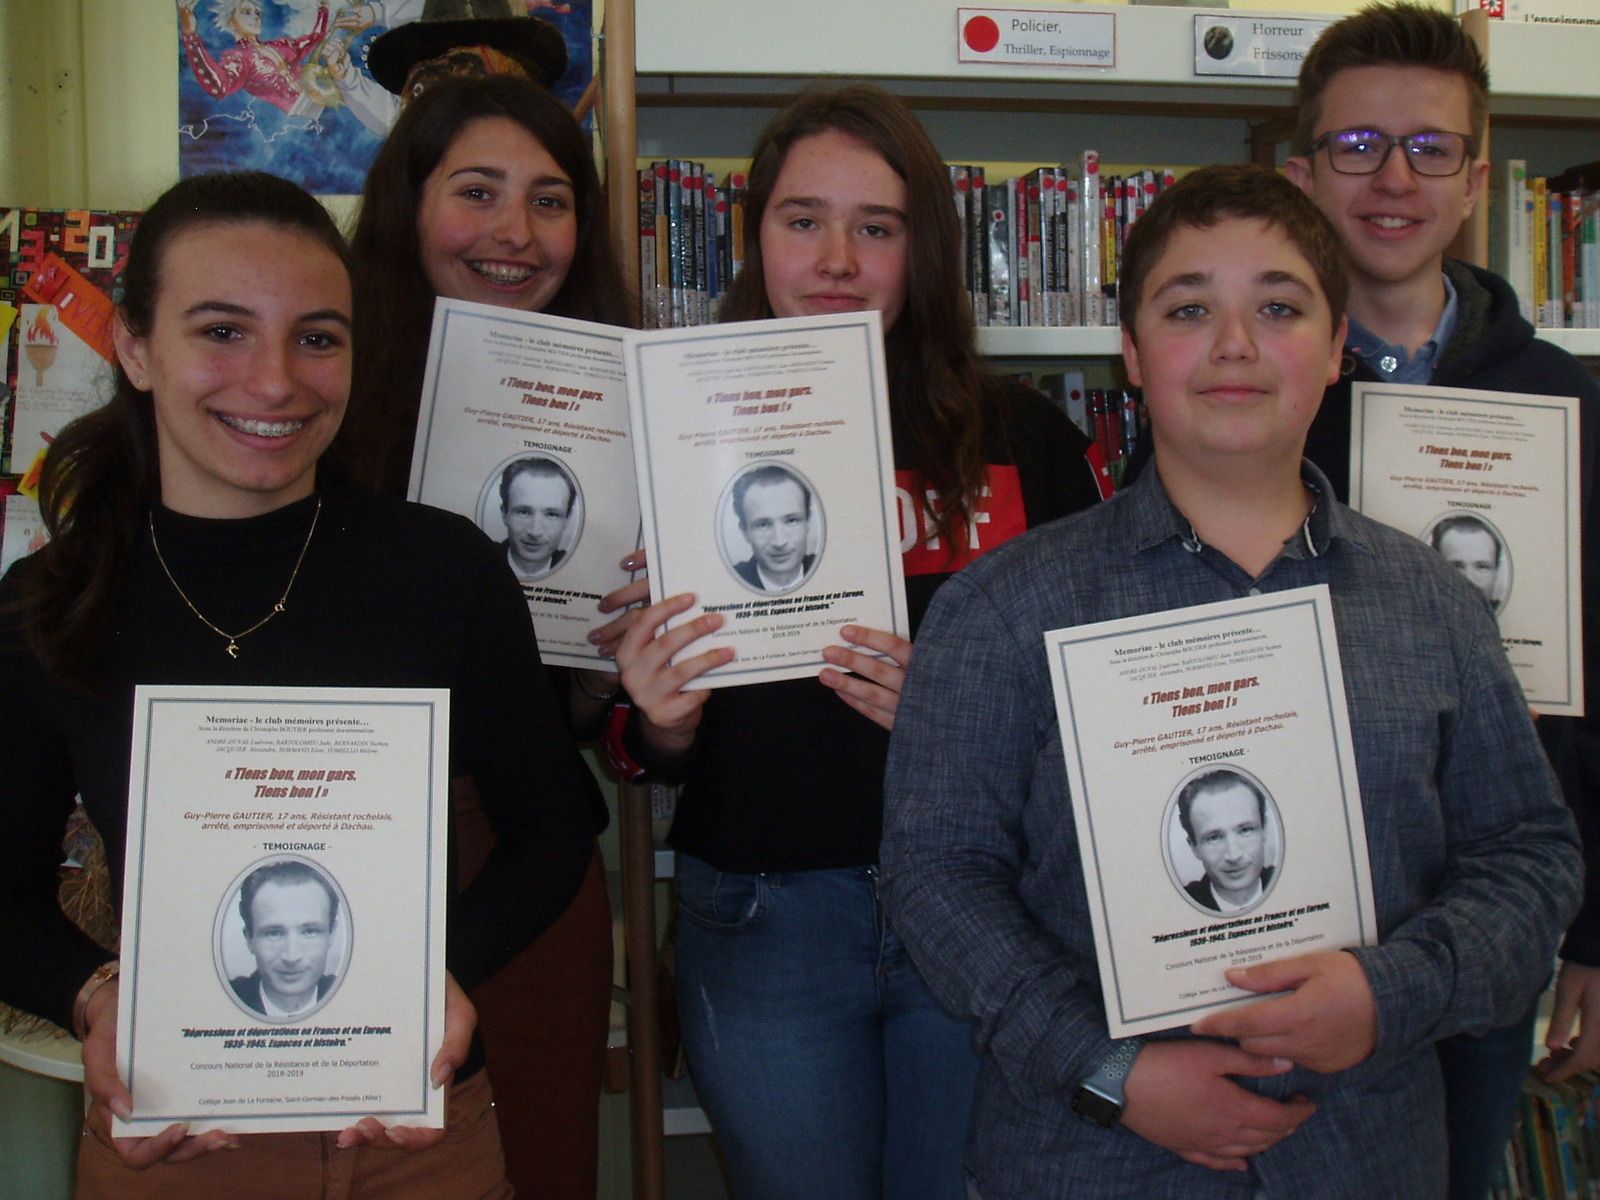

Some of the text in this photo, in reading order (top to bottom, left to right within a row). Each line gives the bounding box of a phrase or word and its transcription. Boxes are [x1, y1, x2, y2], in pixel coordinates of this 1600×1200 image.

[1011, 18, 1062, 34] Policier,
[1252, 23, 1304, 36] Horreur
[1050, 44, 1110, 59] Espionnage
[1149, 688, 1180, 704] Tiens
[1206, 680, 1232, 694] mon
[1171, 697, 1224, 717] Tiens bon
[1189, 747, 1244, 764] TEMOIGNAGE
[233, 767, 267, 779] Tiens
[297, 770, 325, 780] mon
[254, 785, 288, 797] Tiens
[289, 785, 313, 797] bon
[184, 812, 230, 820] Guy-Pierre
